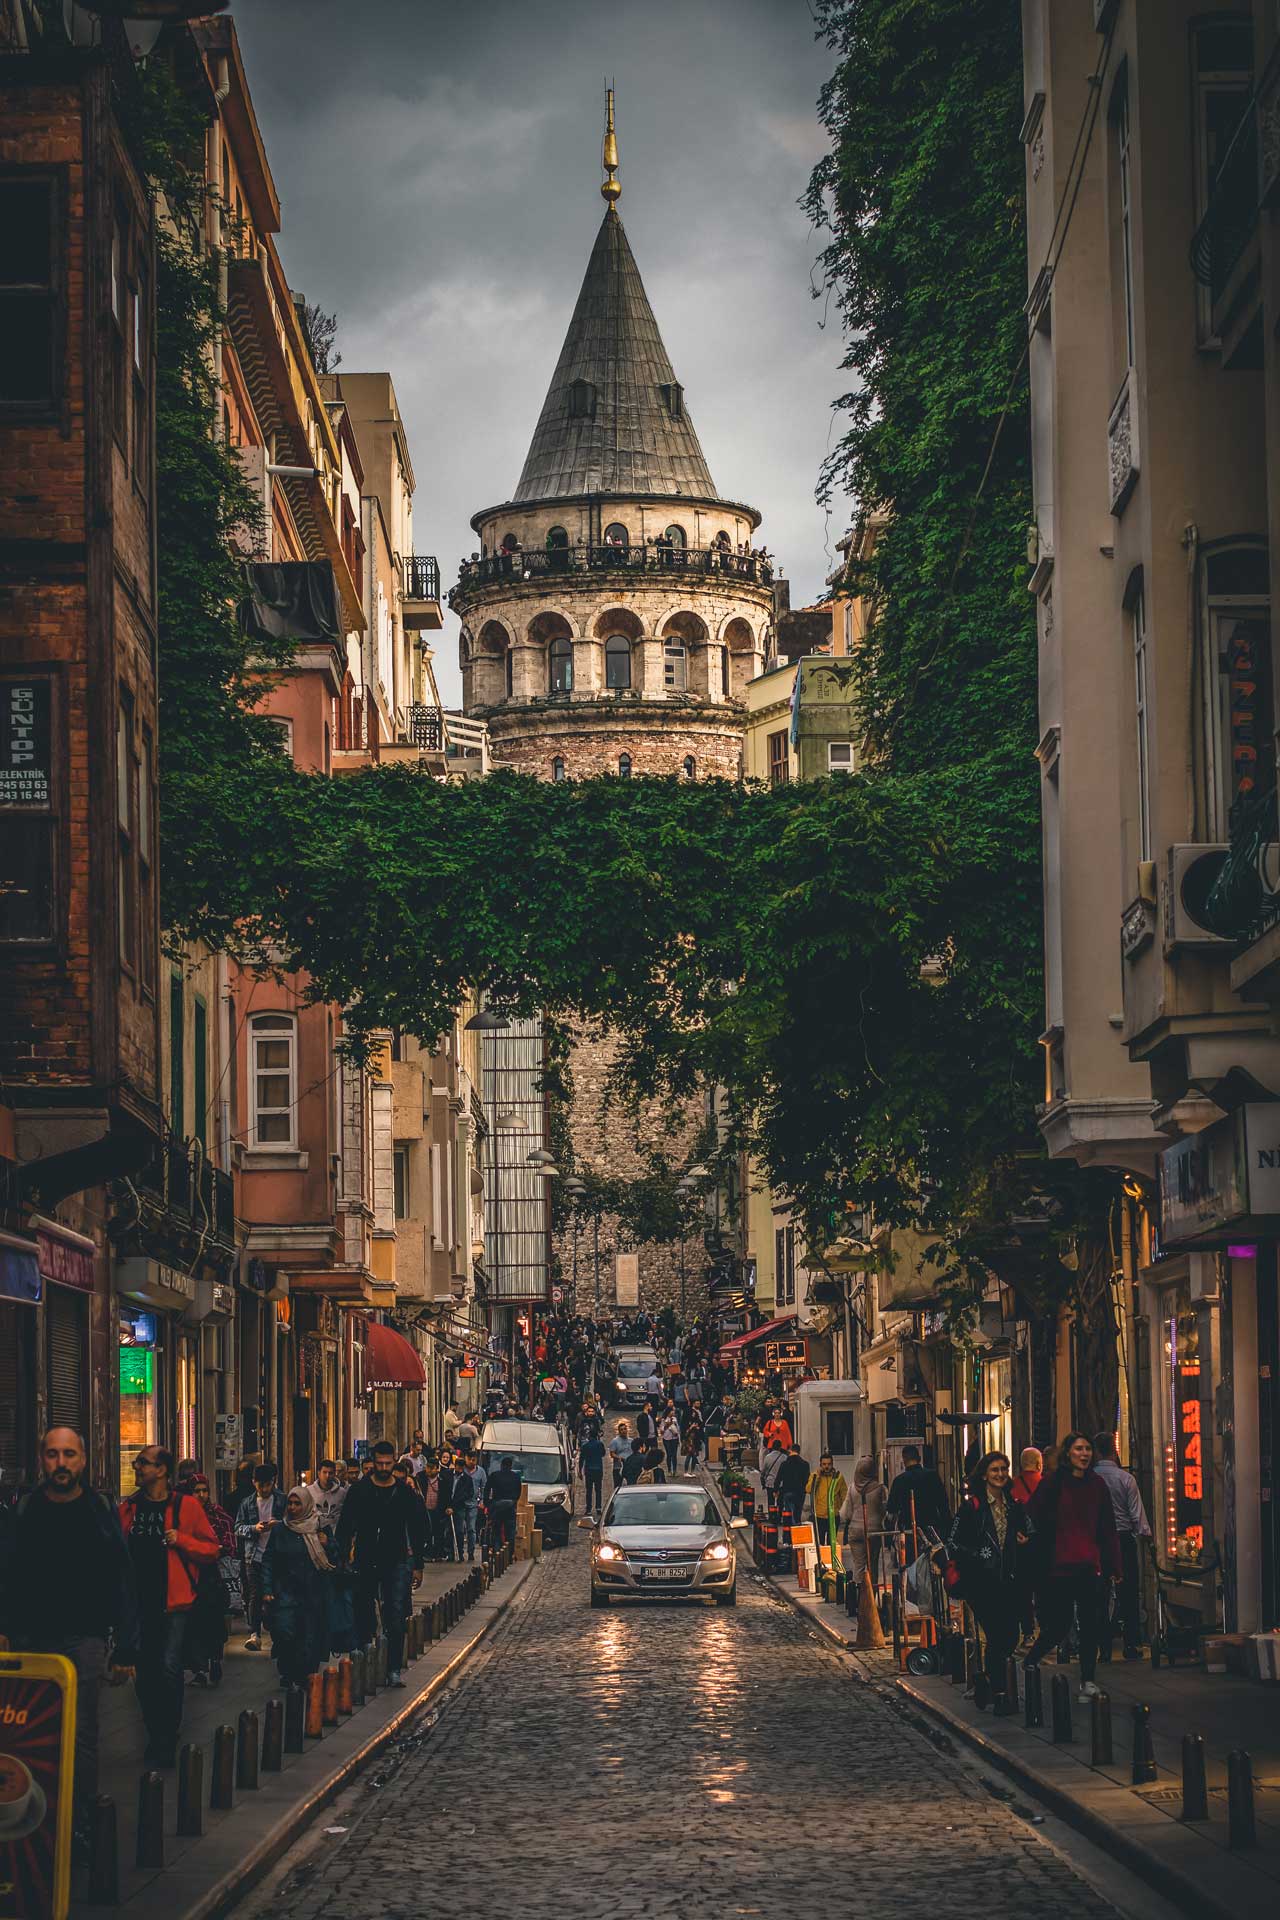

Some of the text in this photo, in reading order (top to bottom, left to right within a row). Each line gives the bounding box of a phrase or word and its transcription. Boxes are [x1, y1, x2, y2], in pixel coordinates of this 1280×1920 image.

[11, 688, 34, 764] GÜNTOP
[19, 780, 33, 789] 63
[34, 780, 48, 789] 63
